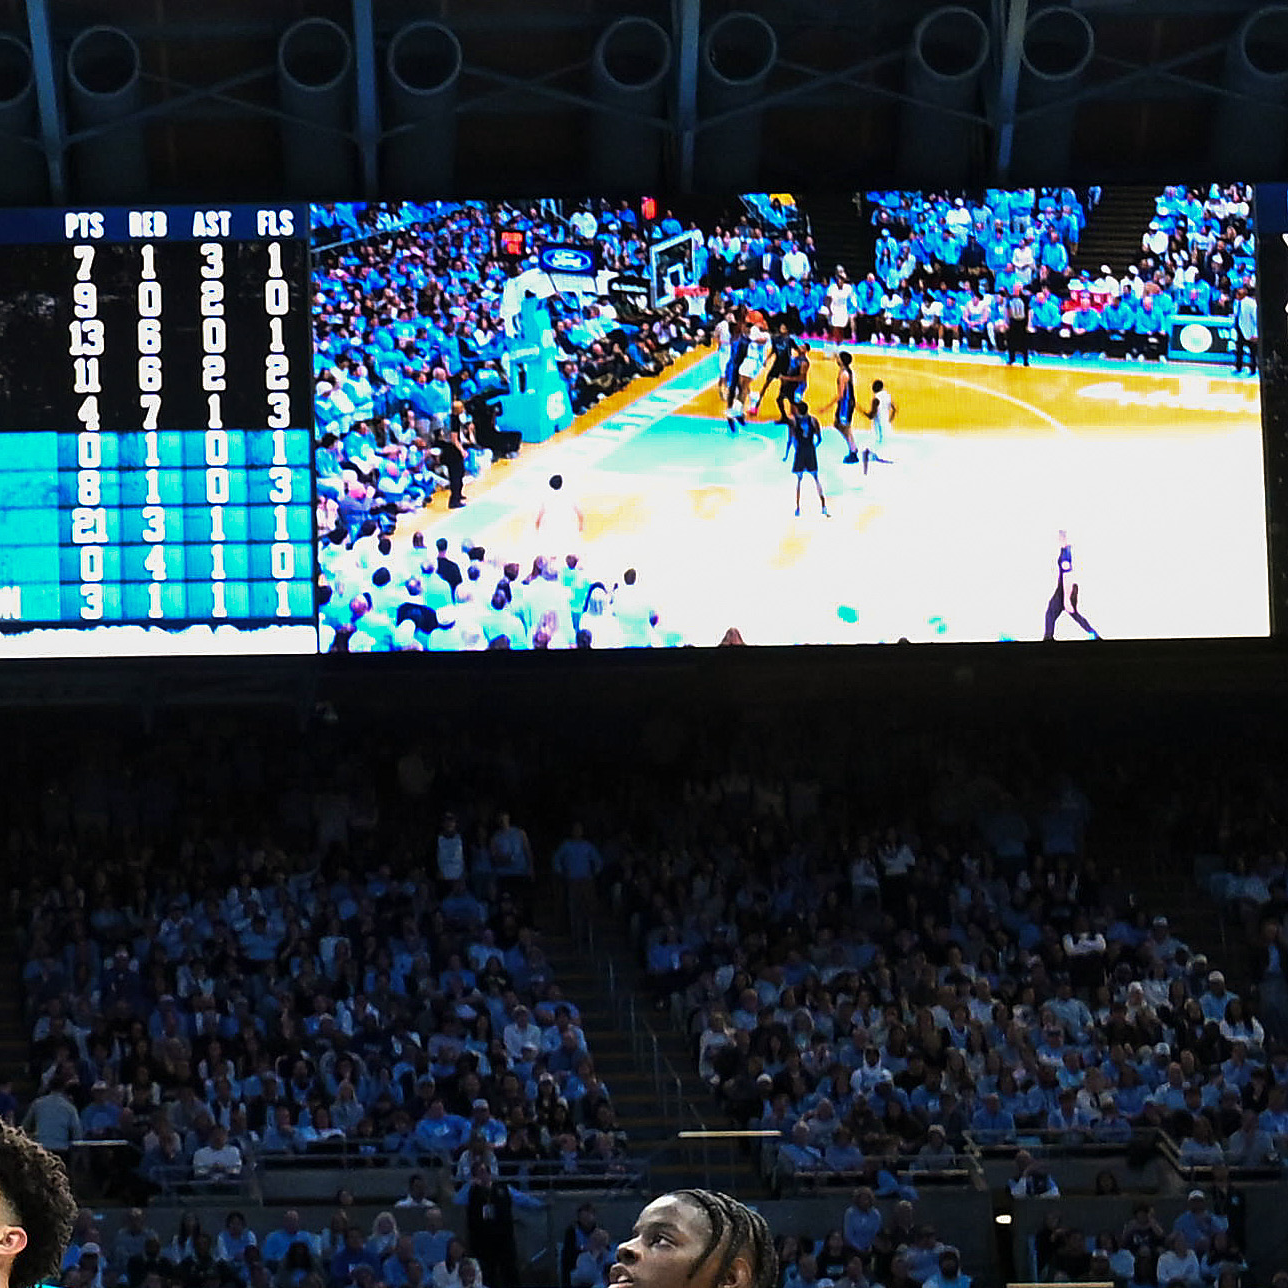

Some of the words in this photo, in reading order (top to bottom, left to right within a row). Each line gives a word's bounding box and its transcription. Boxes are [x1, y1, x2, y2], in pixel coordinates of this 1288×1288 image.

[65, 212, 104, 238] PTS
[129, 212, 167, 237] REB
[193, 211, 231, 237] AST
[257, 210, 294, 236] FLS
[74, 245, 95, 281] 7
[141, 244, 156, 279] 1
[200, 243, 223, 279] 3
[268, 242, 283, 278] 1
[74, 282, 97, 318] 9
[138, 281, 162, 317] 0
[200, 280, 224, 316] 2
[265, 279, 289, 315] 0
[69, 320, 104, 356] 13
[138, 318, 161, 354] 6
[203, 317, 226, 353] 0
[270, 317, 285, 353] 1
[74, 357, 102, 393] 11
[138, 356, 162, 392] 6
[202, 355, 226, 391] 2
[266, 354, 289, 390] 2
[77, 395, 100, 431] 4
[140, 394, 161, 430] 7
[208, 393, 223, 429] 1
[268, 392, 290, 428] 3
[78, 432, 101, 468] 0
[145, 431, 161, 467] 1
[205, 430, 228, 466] 0
[273, 430, 287, 465] 1
[78, 470, 100, 506] 8
[145, 469, 161, 504] 1
[206, 468, 229, 503] 0
[269, 467, 291, 503] 3
[72, 507, 109, 543] 21
[142, 506, 165, 542] 3
[211, 505, 226, 541] 1
[274, 505, 290, 540] 1
[81, 545, 103, 582] 0
[144, 545, 167, 581] 4
[211, 544, 226, 580] 1
[271, 543, 294, 579] 0
[80, 584, 103, 619] 3
[148, 582, 164, 618] 1
[211, 581, 227, 618] 1
[275, 581, 291, 617] 1
